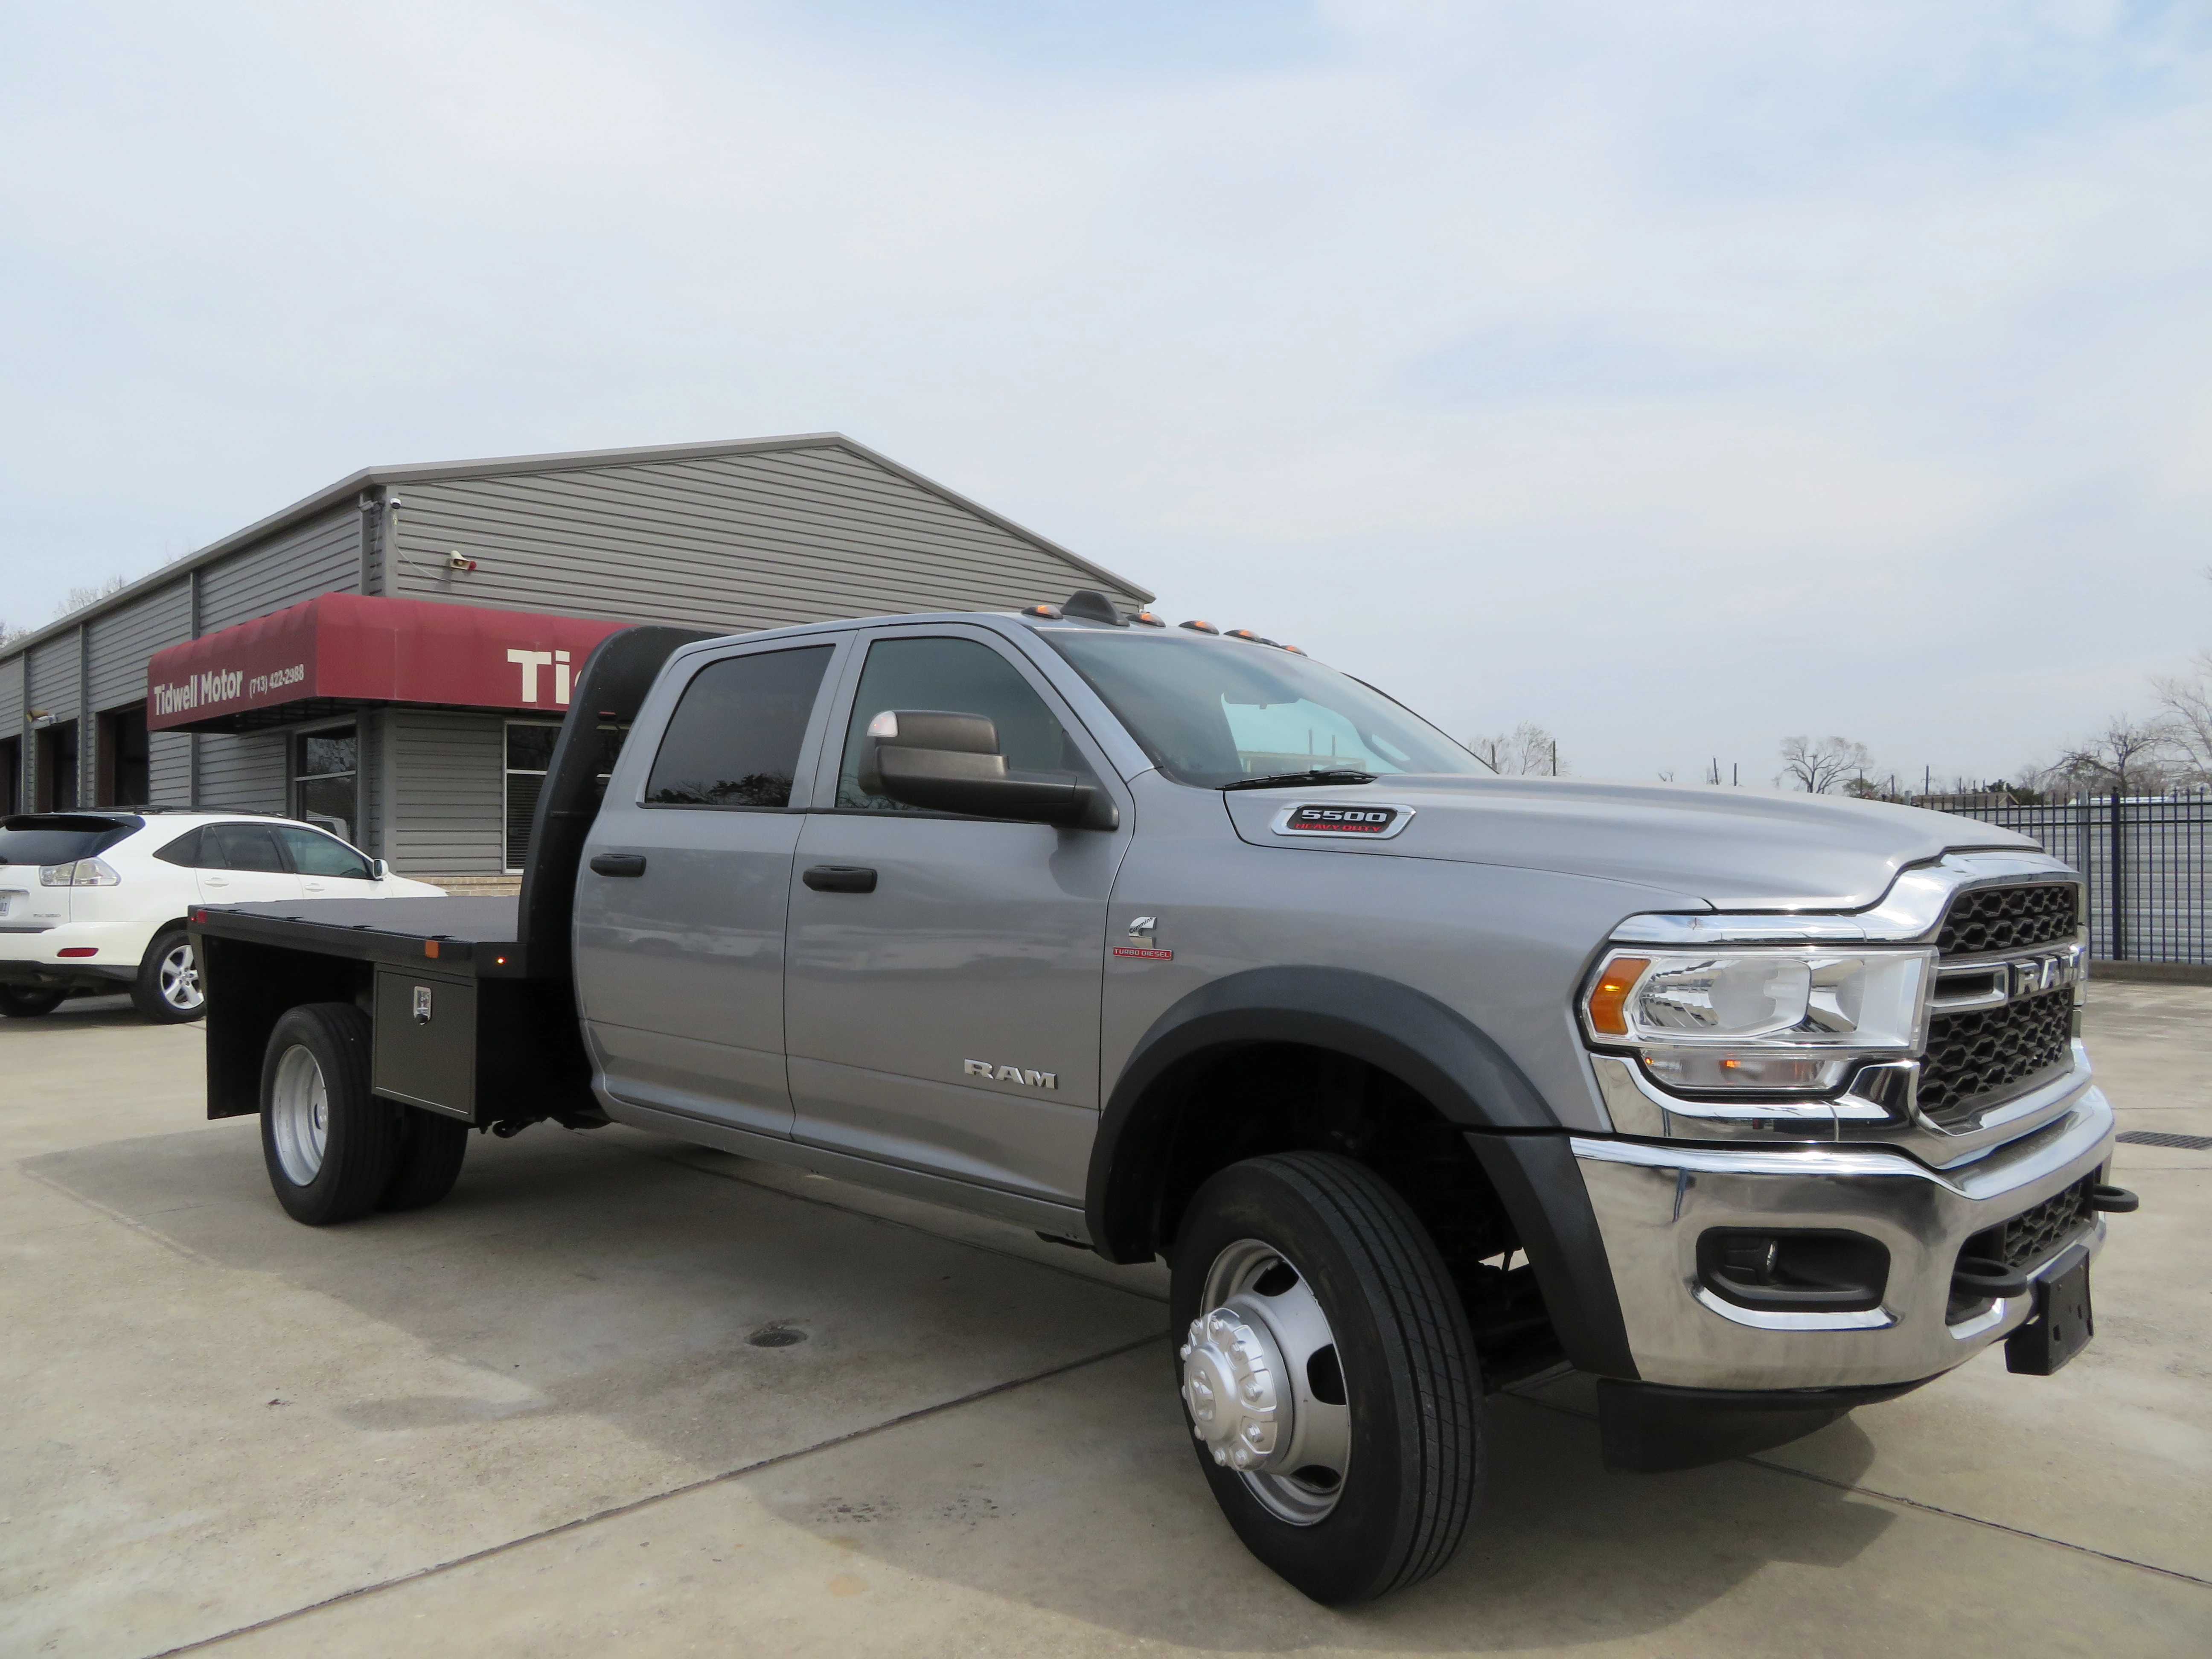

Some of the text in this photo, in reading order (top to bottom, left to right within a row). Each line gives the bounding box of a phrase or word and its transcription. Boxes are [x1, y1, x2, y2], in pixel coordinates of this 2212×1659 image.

[154, 664, 304, 716] Tidwell Motor (713) 422-2988
[507, 649, 582, 704] Ti
[1301, 810, 1387, 823] 5500
[1129, 917, 1153, 934] Cummins
[964, 1058, 1058, 1089] RAM
